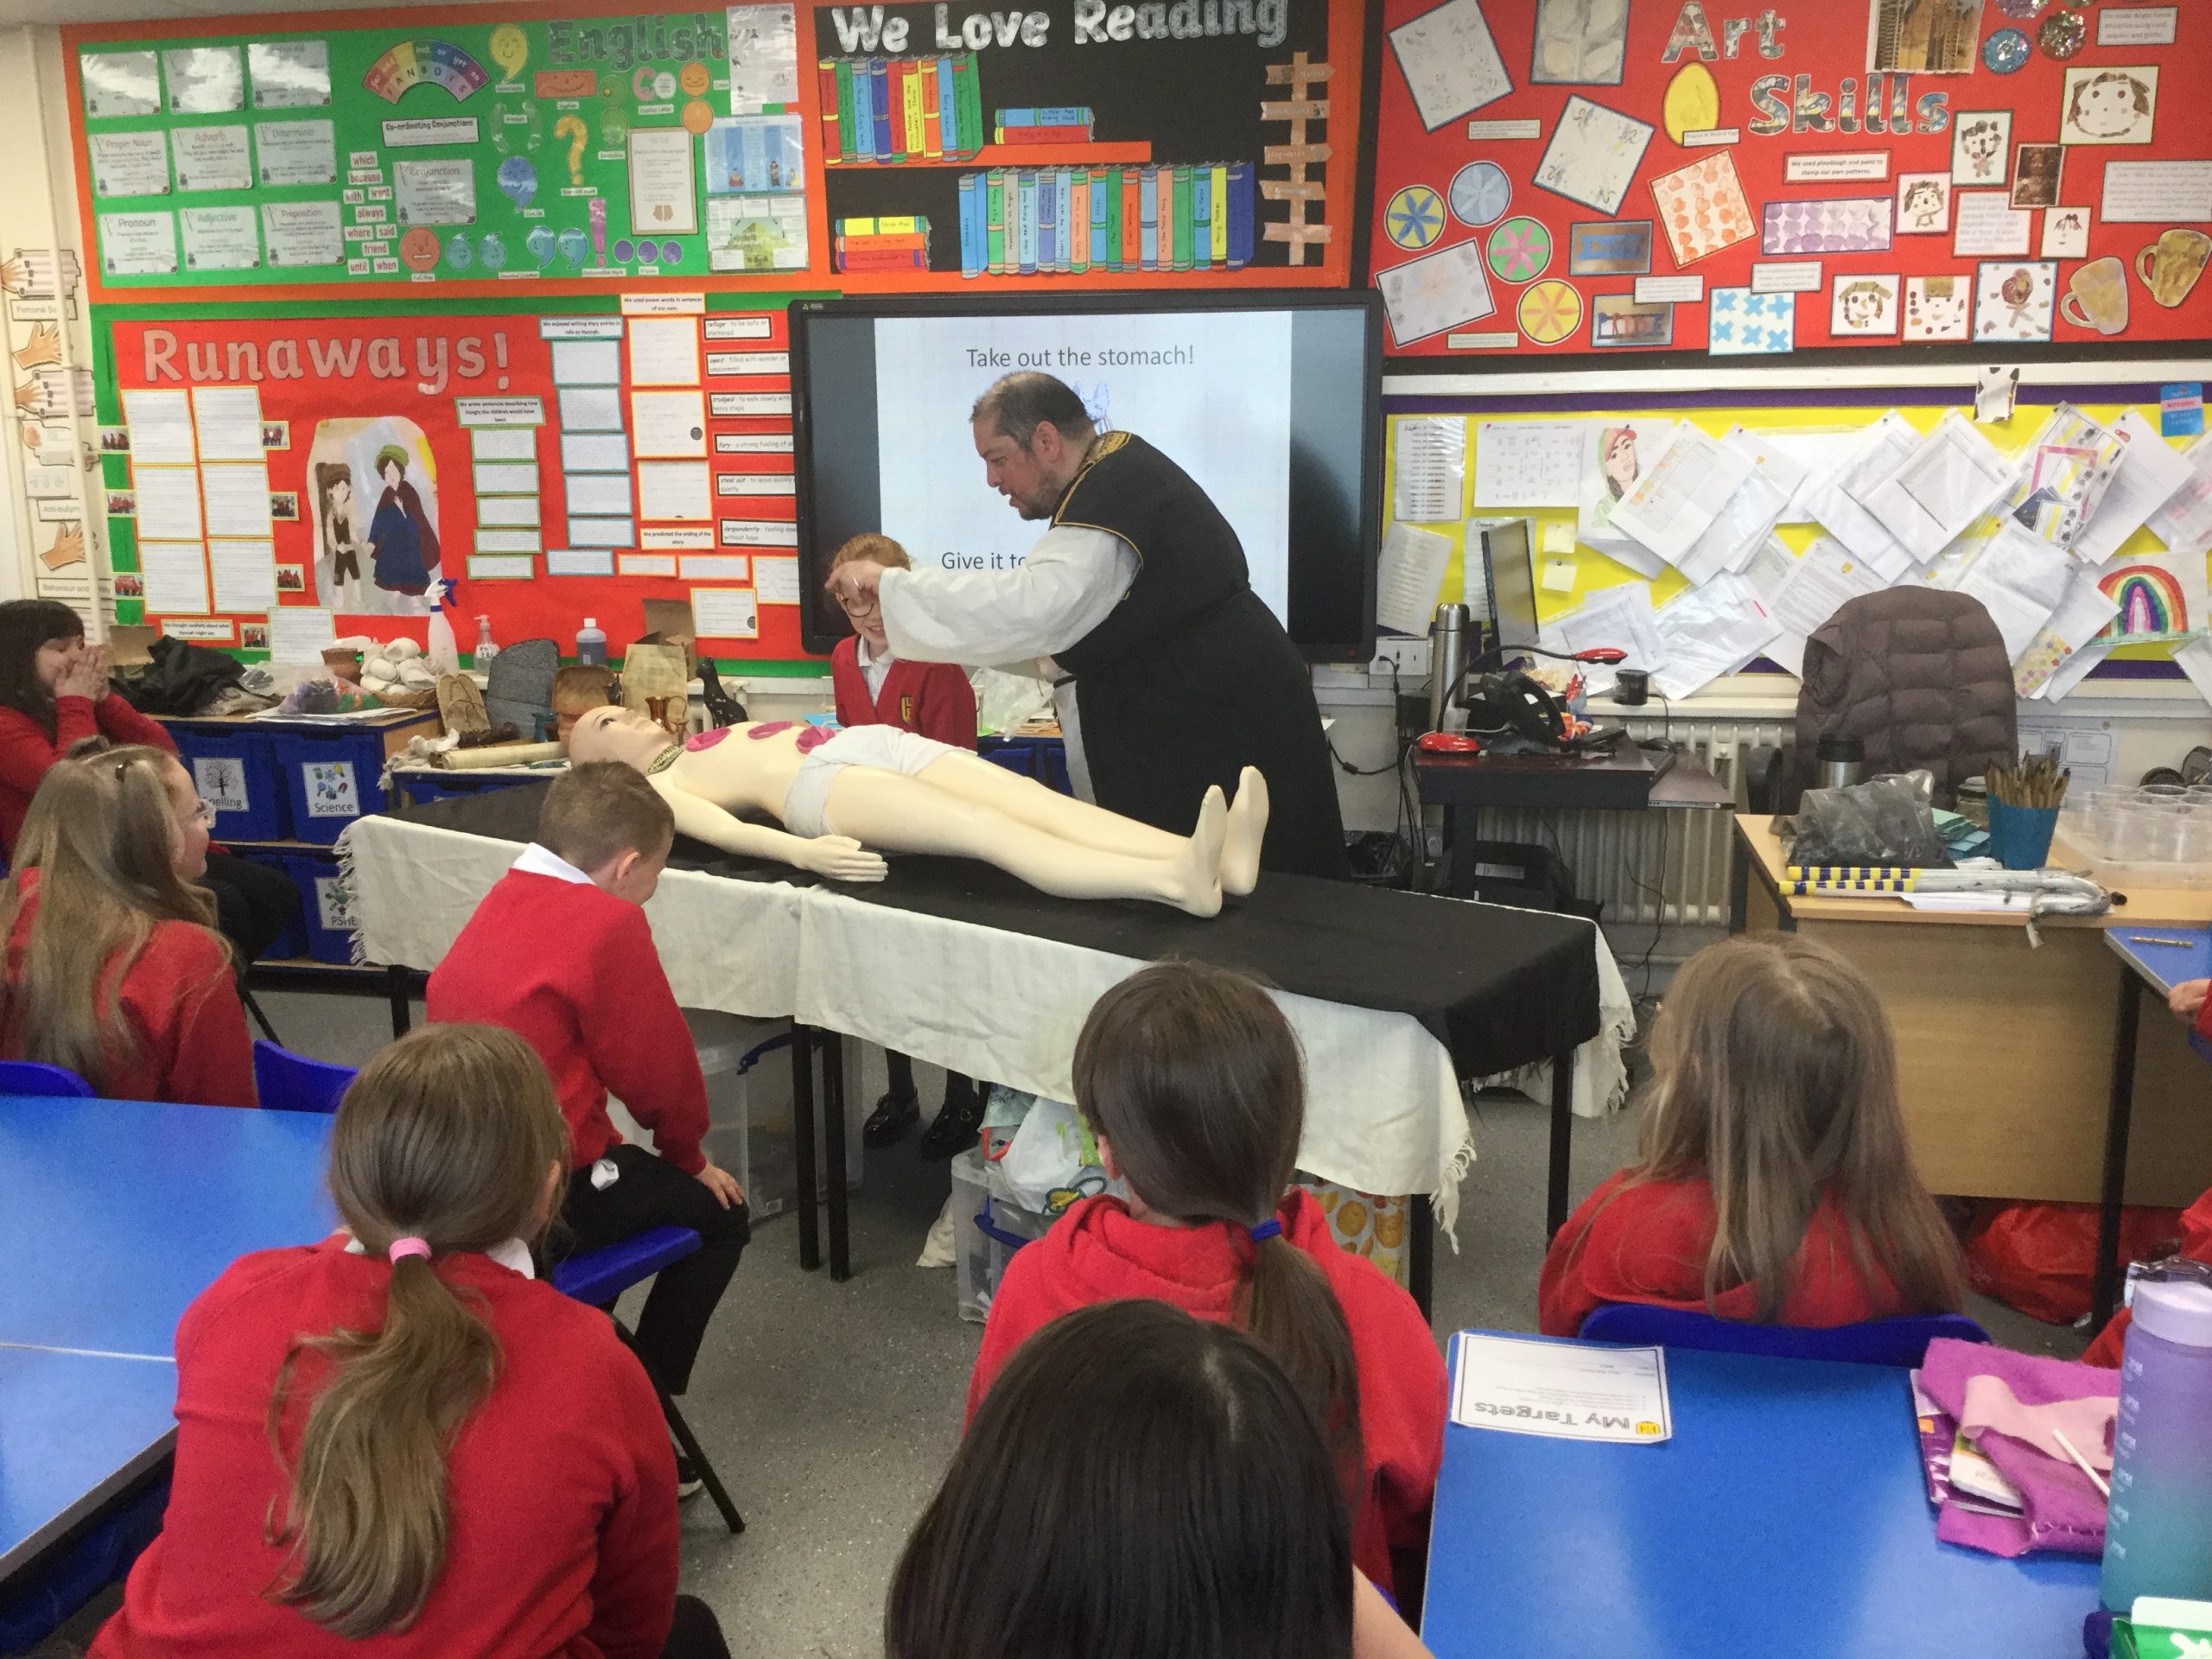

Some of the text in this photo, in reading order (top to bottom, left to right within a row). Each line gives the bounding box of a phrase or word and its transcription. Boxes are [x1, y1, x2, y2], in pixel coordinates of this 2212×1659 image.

[831, 0, 1288, 53] We Love Reading
[1662, 1, 1786, 63] Art
[548, 13, 727, 72] English
[1748, 73, 1950, 134] Skills
[386, 120, 474, 131] Co-ordinating Conjunctions
[194, 130, 226, 143] Adverb
[1268, 149, 1306, 159] Hogwarts
[353, 155, 376, 166] which
[350, 172, 381, 184] because
[345, 191, 362, 202] with
[370, 188, 391, 198] went
[197, 212, 238, 225] Adjective
[281, 209, 323, 219] Preposition
[357, 208, 384, 219] always
[118, 218, 156, 228] Pronoun
[347, 228, 371, 238] where
[379, 226, 395, 237] said
[364, 243, 387, 254] friend
[350, 262, 367, 273] until
[375, 260, 397, 270] when
[16, 305, 46, 313] Personal
[142, 327, 511, 396] Runaways!
[966, 345, 1194, 368] Take out the stomach!
[941, 551, 984, 570] Give
[989, 551, 1004, 569] it
[42, 583, 76, 591] Behaviour
[315, 803, 353, 814] Science
[1474, 1401, 1630, 1429] My Targets
